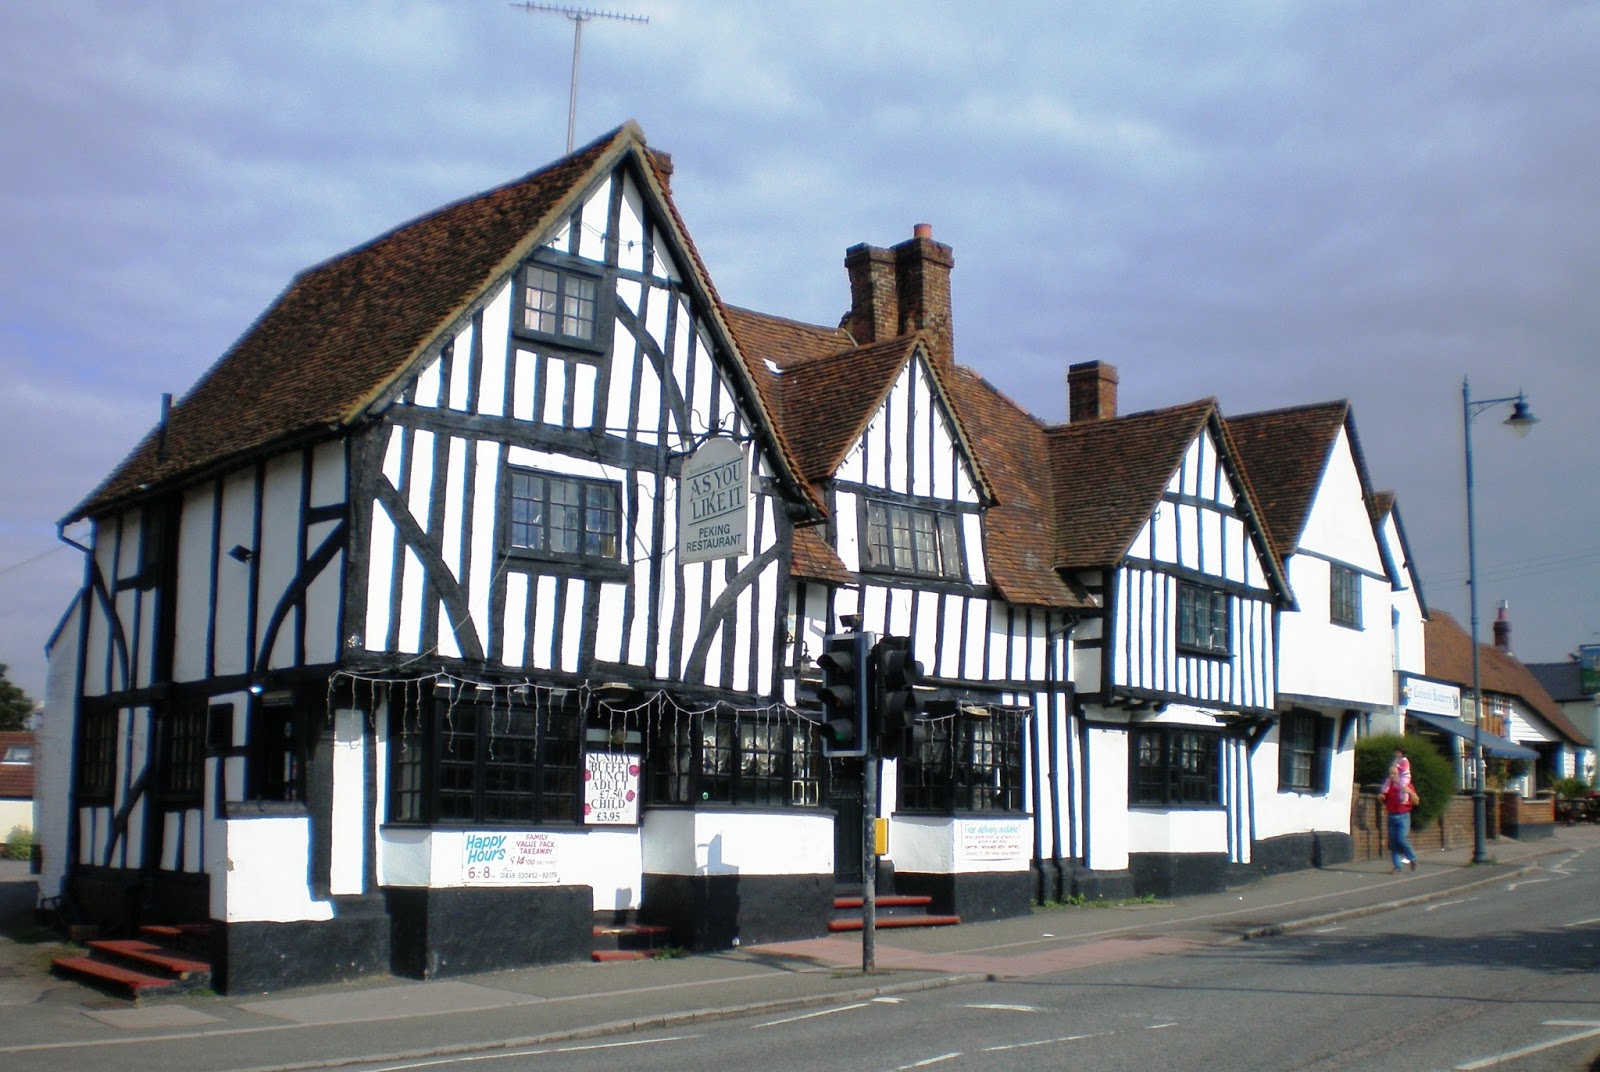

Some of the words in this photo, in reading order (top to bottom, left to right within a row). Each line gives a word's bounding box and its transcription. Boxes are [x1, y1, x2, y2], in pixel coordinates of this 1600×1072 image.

[690, 474, 712, 501] AS
[714, 462, 742, 488] YOU
[692, 491, 727, 520] LIKE
[728, 486, 743, 508] IT
[698, 523, 731, 539] PEKING
[686, 533, 742, 553] RESTAURANT
[589, 753, 631, 765] SUNDAY
[590, 762, 629, 773] BUFFET
[592, 771, 629, 782] LUNCH
[592, 780, 627, 791] ADULT
[591, 799, 626, 810] CHILD
[596, 811, 621, 822] £3.95
[466, 834, 507, 851] Happy
[525, 833, 549, 841] FAMILY
[467, 848, 506, 865] Hours
[519, 847, 553, 855] TAKEAWAY
